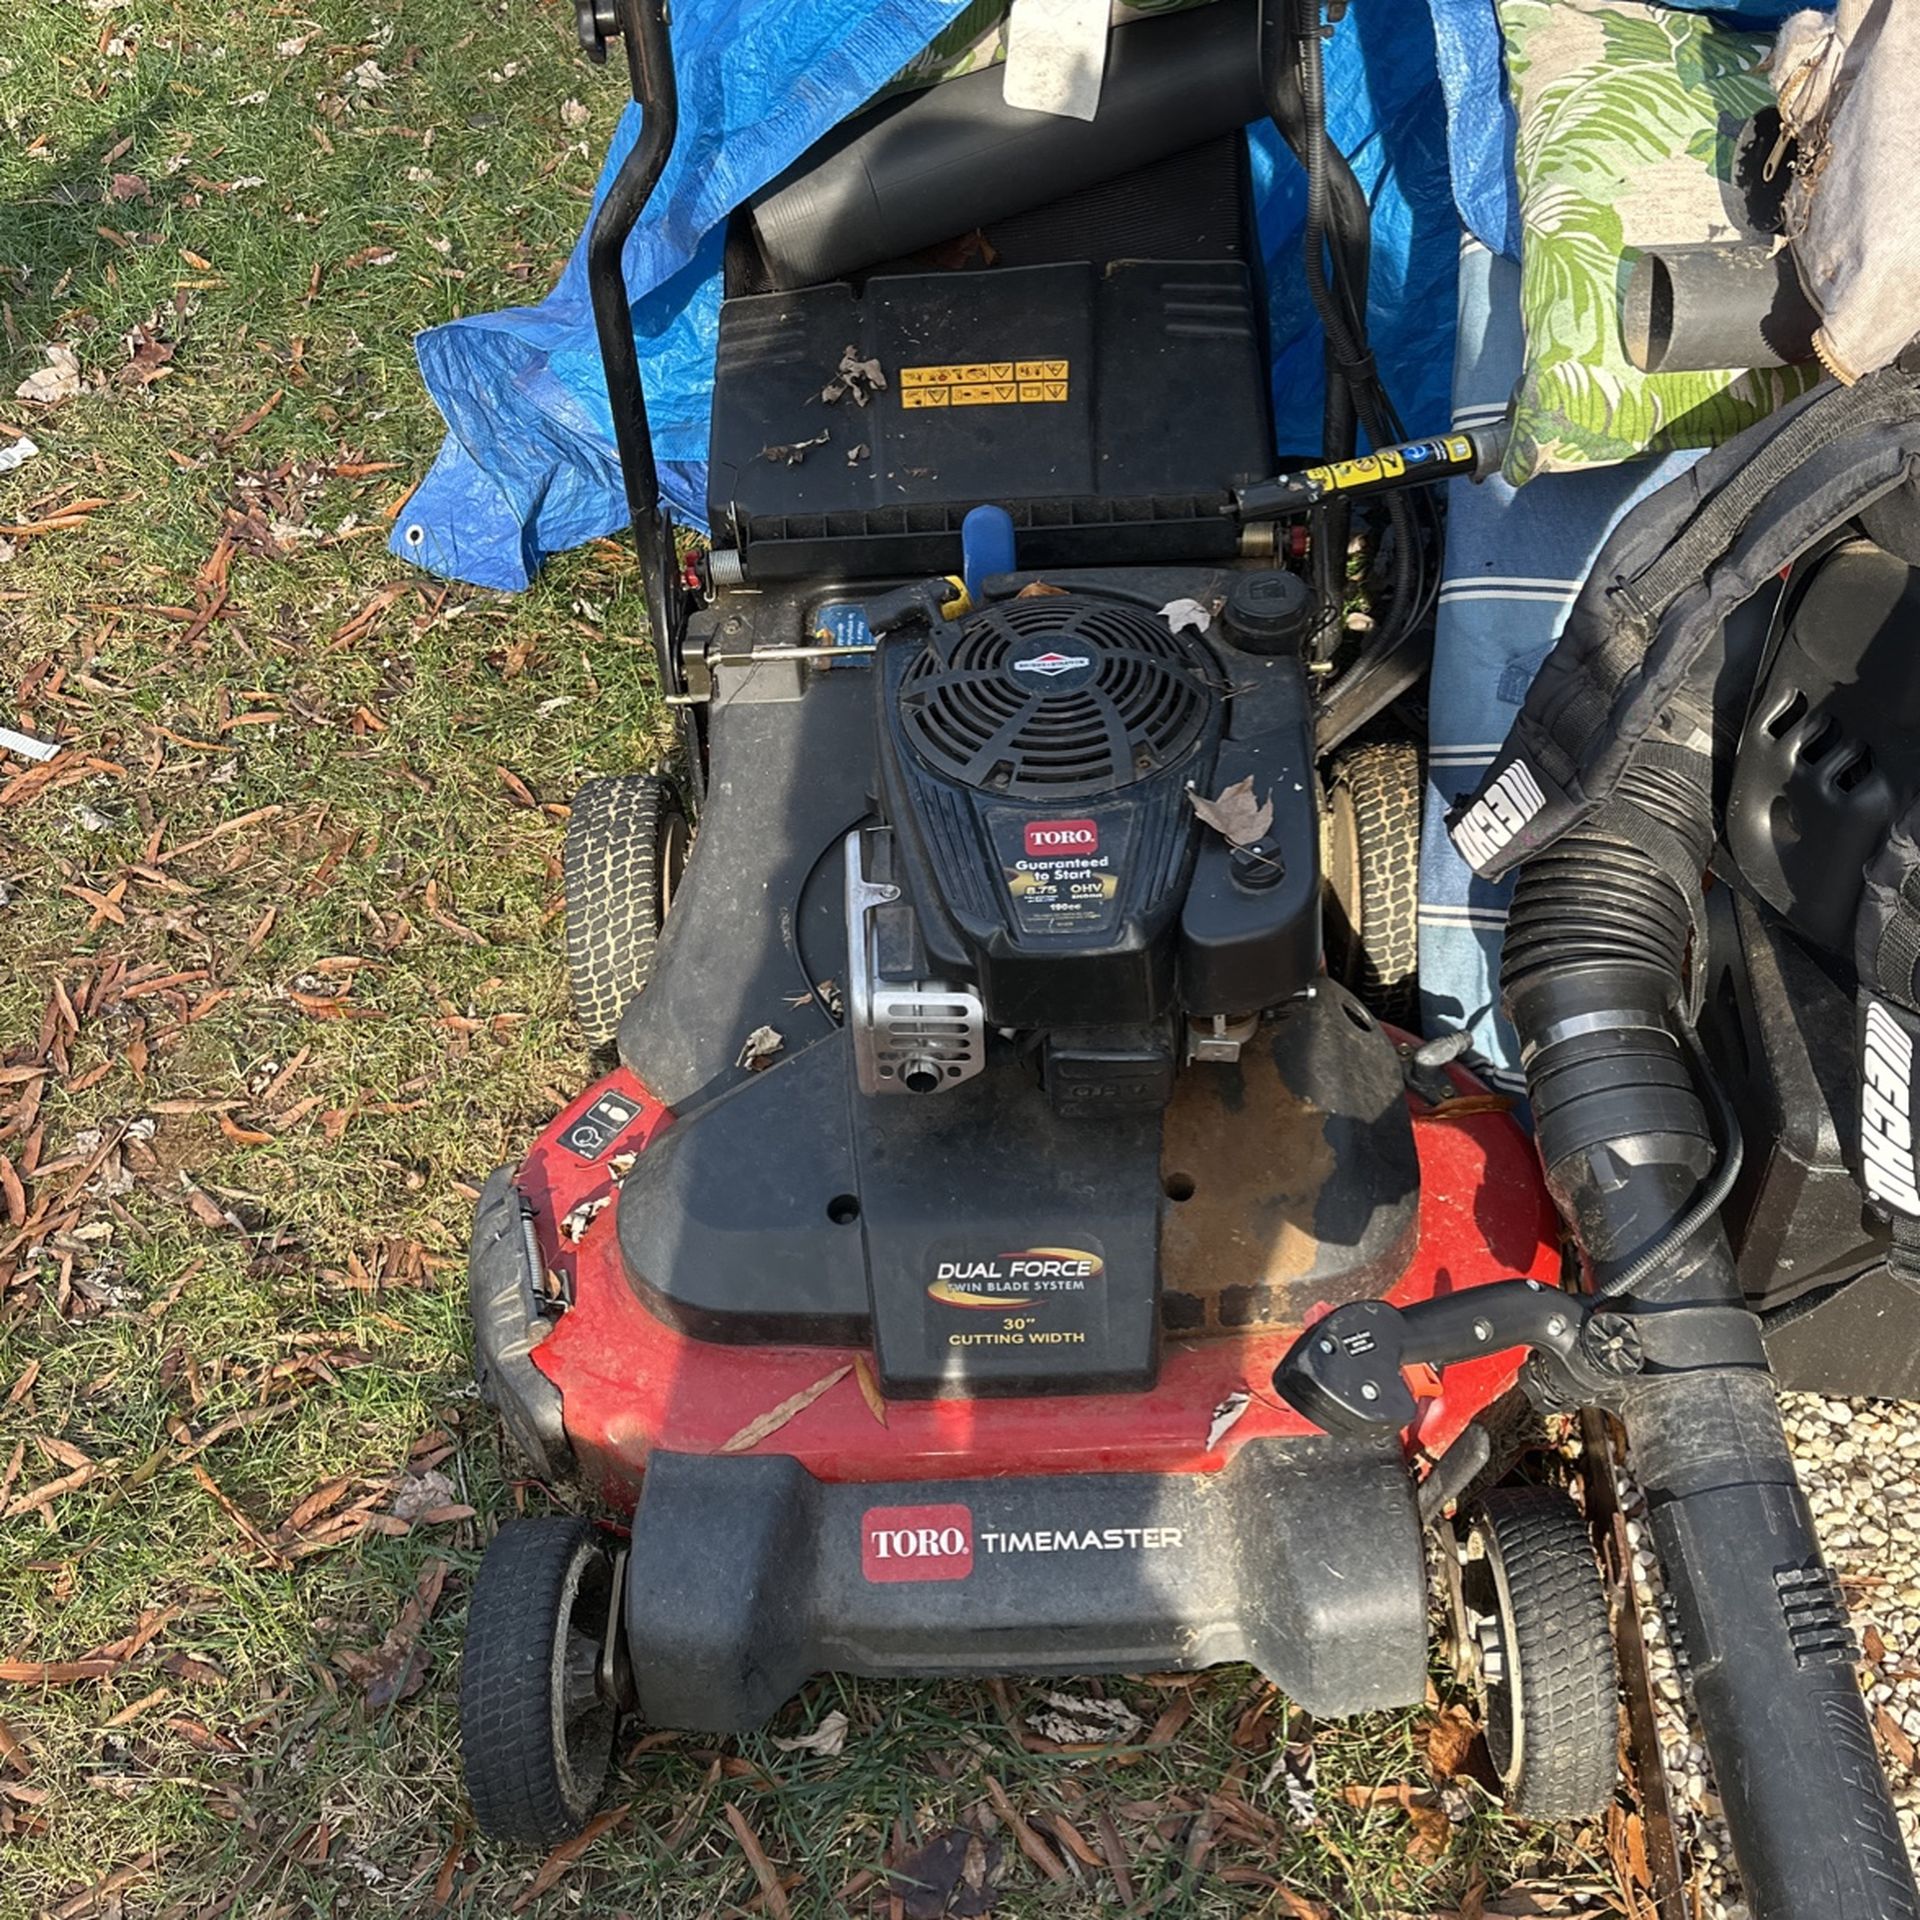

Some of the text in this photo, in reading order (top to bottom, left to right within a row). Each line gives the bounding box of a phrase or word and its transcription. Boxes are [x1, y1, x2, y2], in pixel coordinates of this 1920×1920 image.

[1453, 782, 1527, 871] ECHO
[1030, 829, 1093, 846] TORO
[1015, 856, 1109, 870] Guaranteed
[1034, 869, 1092, 881] to Start
[1070, 883, 1102, 894] OHV
[1860, 1044, 1920, 1216] ECHO
[937, 1260, 1092, 1279] DUAL FORCE
[947, 1280, 1085, 1292] TWIN BLADE SYSTEM
[949, 1332, 1085, 1346] CUTTING WIDTH
[871, 1527, 1183, 1559] TORO TIMEMASTER
